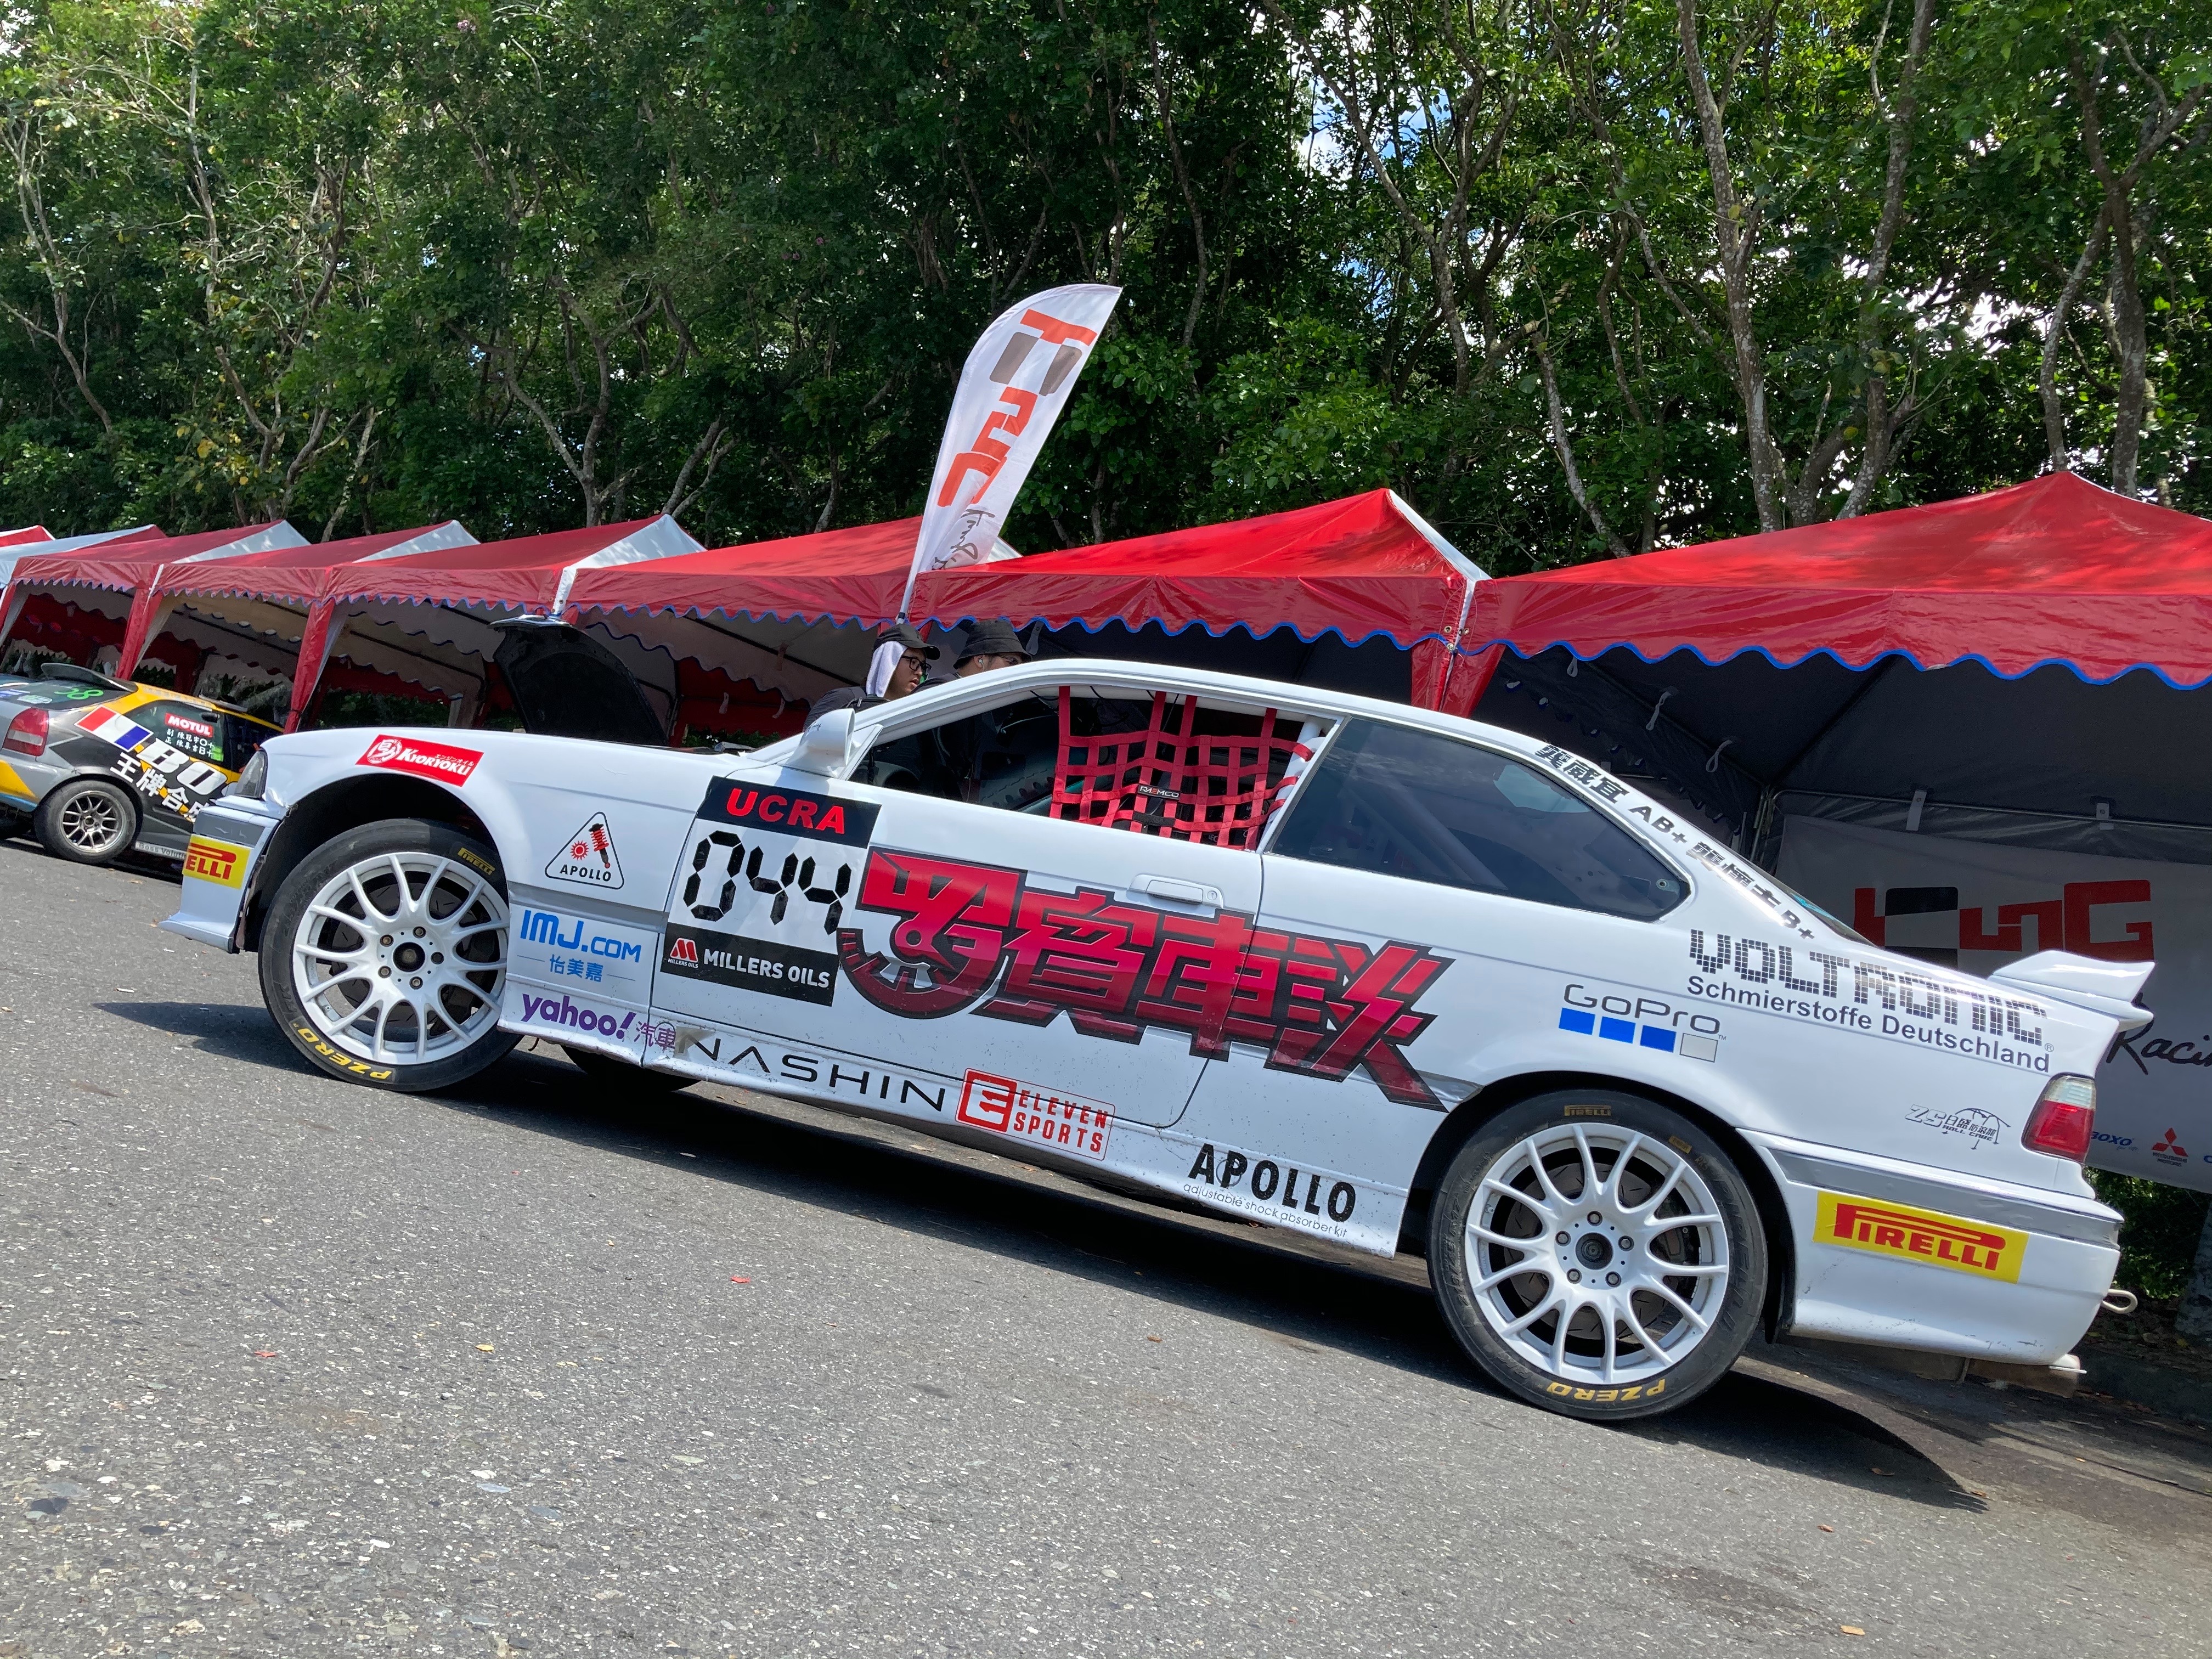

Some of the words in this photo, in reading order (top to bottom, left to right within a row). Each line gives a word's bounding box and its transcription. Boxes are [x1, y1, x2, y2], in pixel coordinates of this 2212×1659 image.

[168, 715, 211, 736] MOTUL
[726, 788, 845, 834] UCRA
[458, 848, 495, 876] PIRELLI
[560, 863, 612, 882] APOLLO
[683, 830, 852, 936] 044
[549, 954, 604, 983] 怡美嘉
[668, 958, 687, 966] MILLERS
[703, 949, 783, 979] MILLERS
[788, 966, 831, 988] OILS
[521, 993, 636, 1040] yahoo!
[1564, 984, 1720, 1035] GoPro
[1688, 975, 1872, 1030] Schmierstoffe
[1882, 1013, 2050, 1073] Deutschland
[634, 1021, 676, 1053] 汽車
[1018, 1090, 1108, 1129] ELEVEN
[1564, 1105, 1611, 1116] PIRELLI
[1012, 1111, 1103, 1153] SPORTS
[1942, 1125, 1965, 1134] ROLL
[1187, 1143, 1356, 1223] APOLLO
[1183, 1183, 1243, 1207] adjustable
[1245, 1201, 1279, 1218] shock
[1280, 1211, 1332, 1233] absorber
[1334, 1226, 1347, 1238] kit
[1833, 1203, 2006, 1272] PIRELLI
